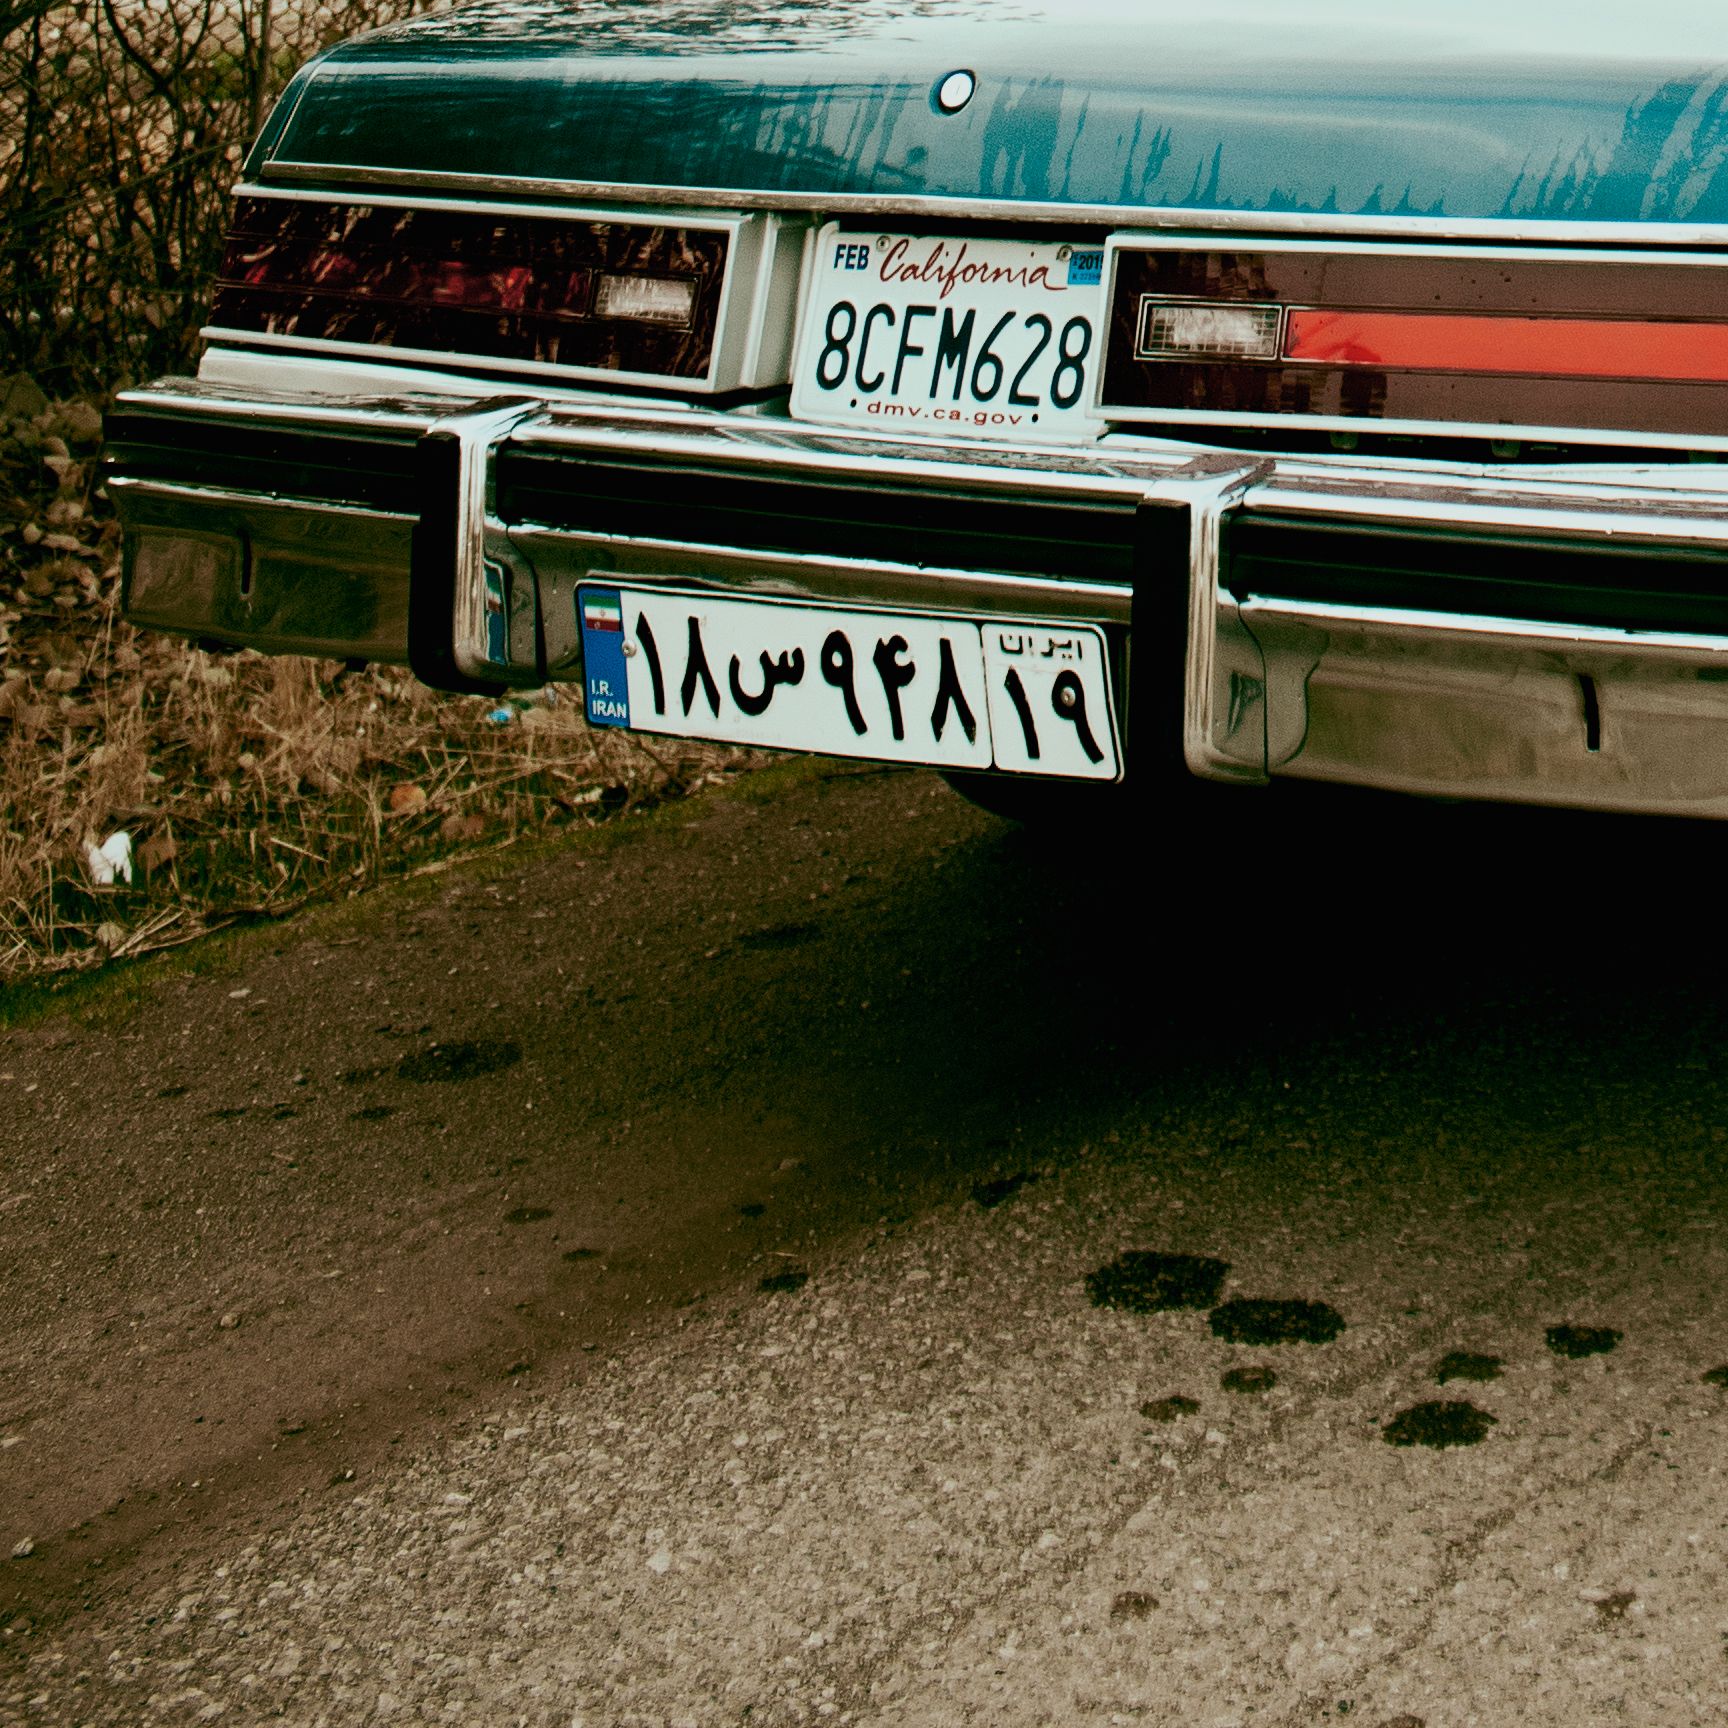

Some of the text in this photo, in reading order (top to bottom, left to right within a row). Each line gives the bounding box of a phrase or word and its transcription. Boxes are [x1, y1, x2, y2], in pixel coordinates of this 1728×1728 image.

[834, 244, 870, 270] FEB
[880, 239, 1067, 299] California
[816, 300, 1093, 410] 8CFM628
[867, 401, 1023, 426] dmv.ca.gov
[1000, 633, 1083, 661] ایران
[591, 679, 614, 697] I.R.
[592, 699, 627, 719] IRAN
[1003, 665, 1105, 764] ۱۹
